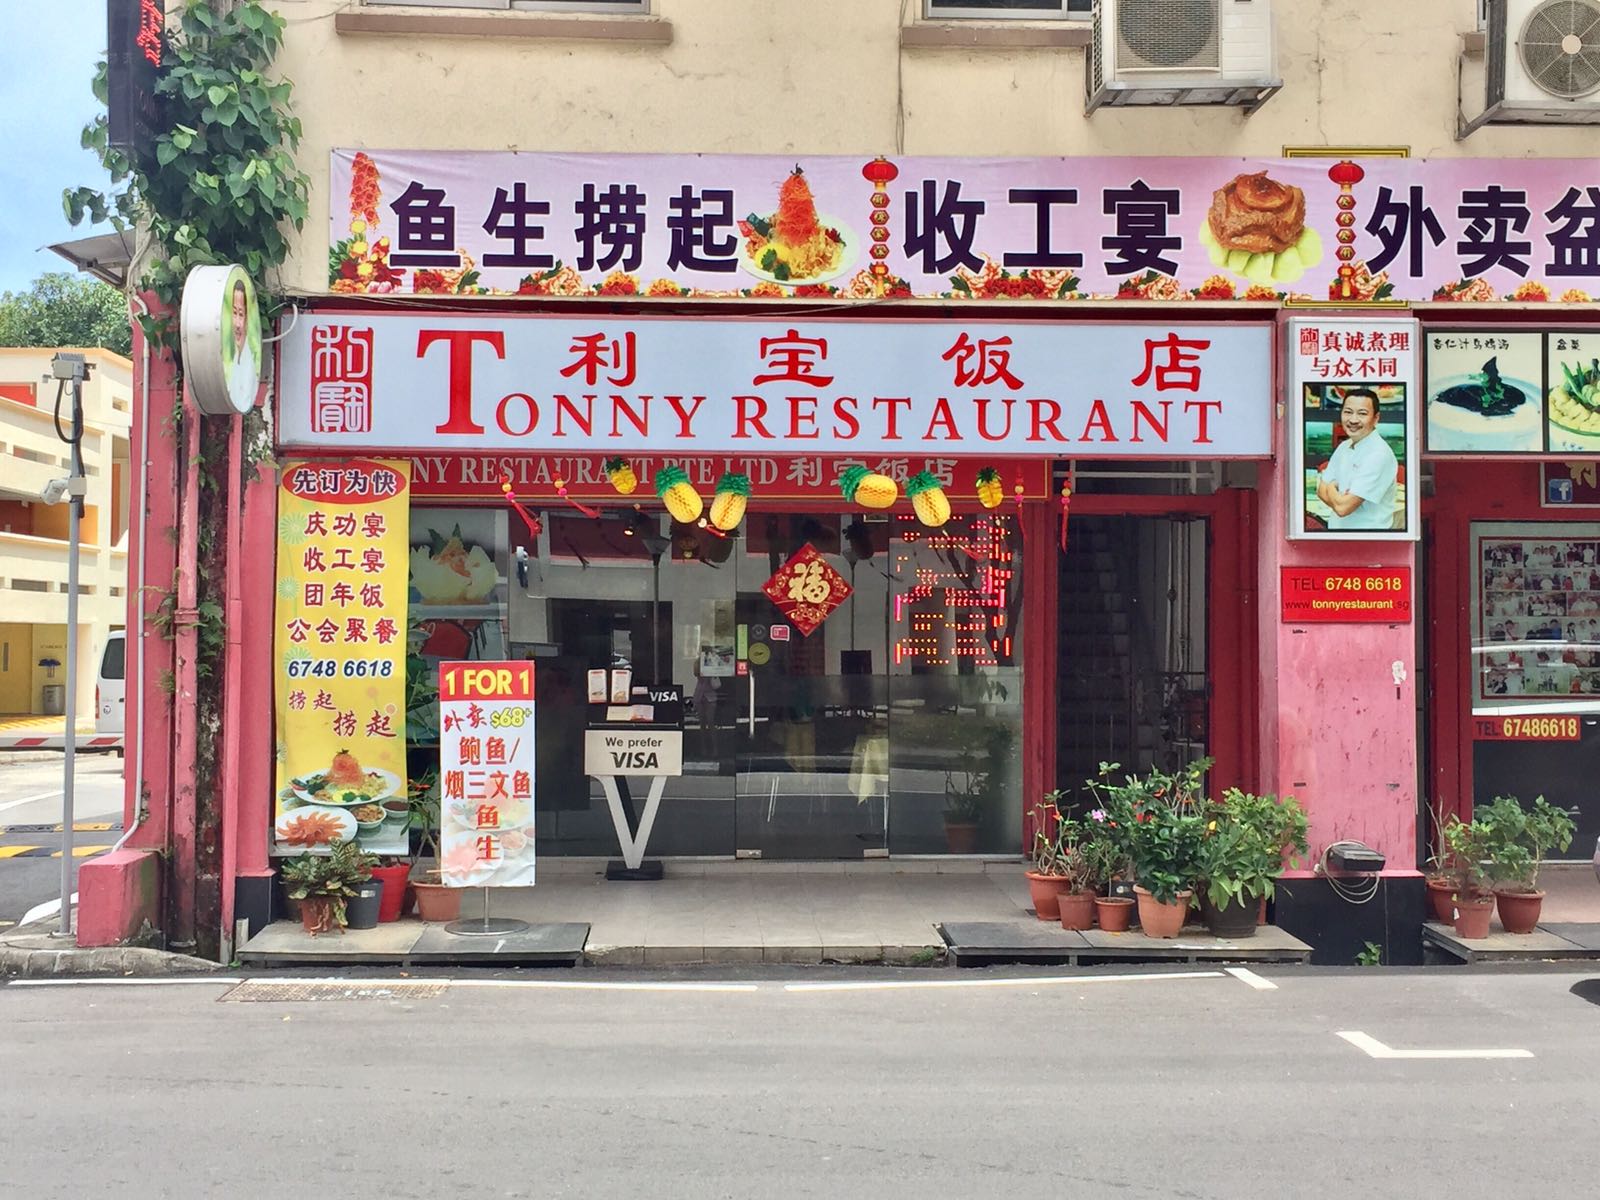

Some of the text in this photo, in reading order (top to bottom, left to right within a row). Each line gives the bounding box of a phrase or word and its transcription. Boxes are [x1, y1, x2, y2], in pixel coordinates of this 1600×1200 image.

[389, 181, 739, 272] 鱼生捞起
[904, 179, 1183, 276] 收工宴
[1322, 331, 1410, 352] 真诚煮理
[560, 329, 1212, 392] 利宝饭店
[1311, 357, 1397, 378] 与众不同
[416, 329, 1223, 444] TONNY RESTAURANT
[294, 470, 396, 493] 先订为快
[460, 457, 653, 485] RESTAURAT
[304, 511, 387, 538] 庆功宴
[303, 547, 385, 573] 收工宴
[304, 582, 385, 608] 团年饭
[1325, 577, 1362, 591] 6748
[1365, 577, 1402, 591] 6618
[287, 618, 398, 644] 公会聚餐
[288, 660, 393, 678] 6748 6618
[445, 669, 529, 696] 1 FOR 1
[288, 689, 336, 711] 捞起
[650, 691, 678, 702] VISA
[333, 709, 397, 738] 捞起
[444, 702, 487, 732] 外卖
[1503, 718, 1578, 737] 67486618
[605, 737, 663, 750] We prefer
[611, 752, 659, 768] VISA
[445, 770, 532, 799] 烟三文鱼
[476, 804, 501, 861] 鱼生
